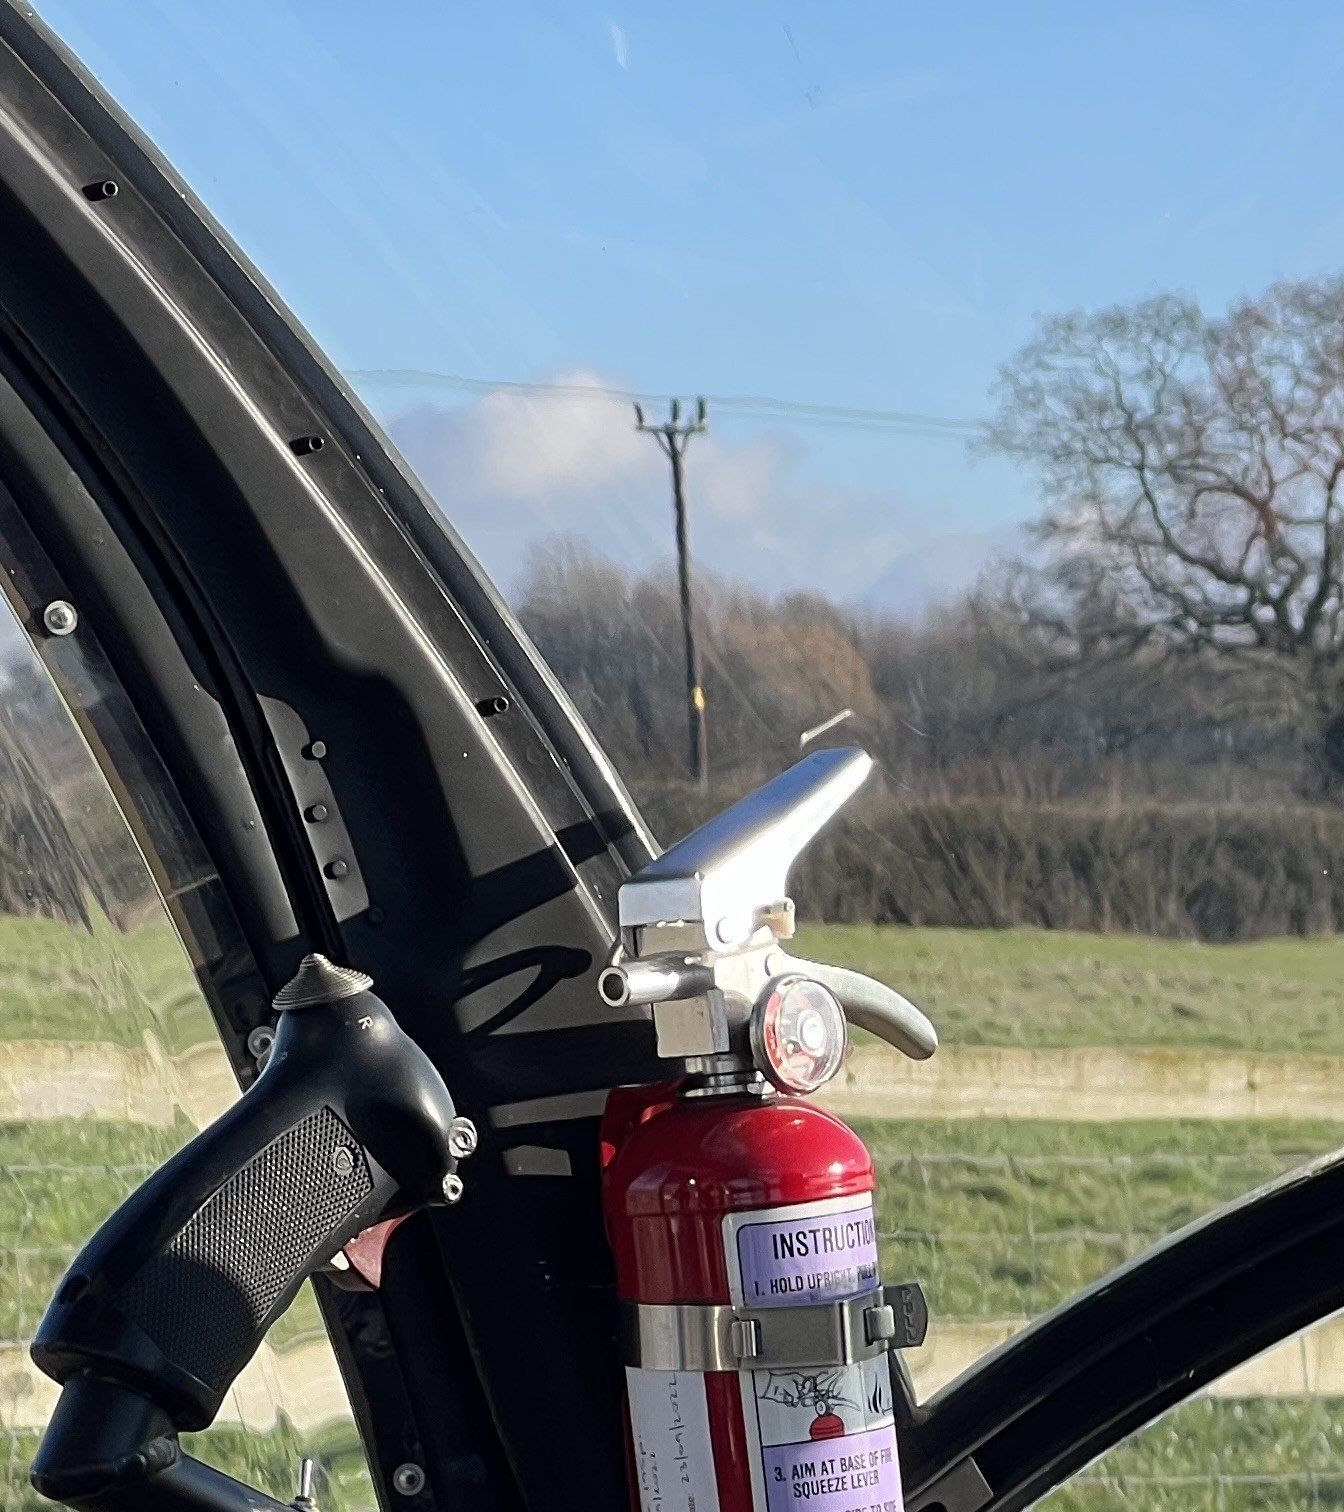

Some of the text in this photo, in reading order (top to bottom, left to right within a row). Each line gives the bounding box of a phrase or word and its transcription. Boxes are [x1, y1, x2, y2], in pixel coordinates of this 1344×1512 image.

[358, 1016, 373, 1029] R
[770, 1275, 804, 1294] HOLD
[774, 1467, 786, 1482] 3.
[792, 1461, 816, 1481] AIM
[821, 1459, 835, 1476] AT
[840, 1453, 866, 1472] BASE
[869, 1451, 879, 1467] OF
[793, 1470, 879, 1499] SQUEEZE LEVER
